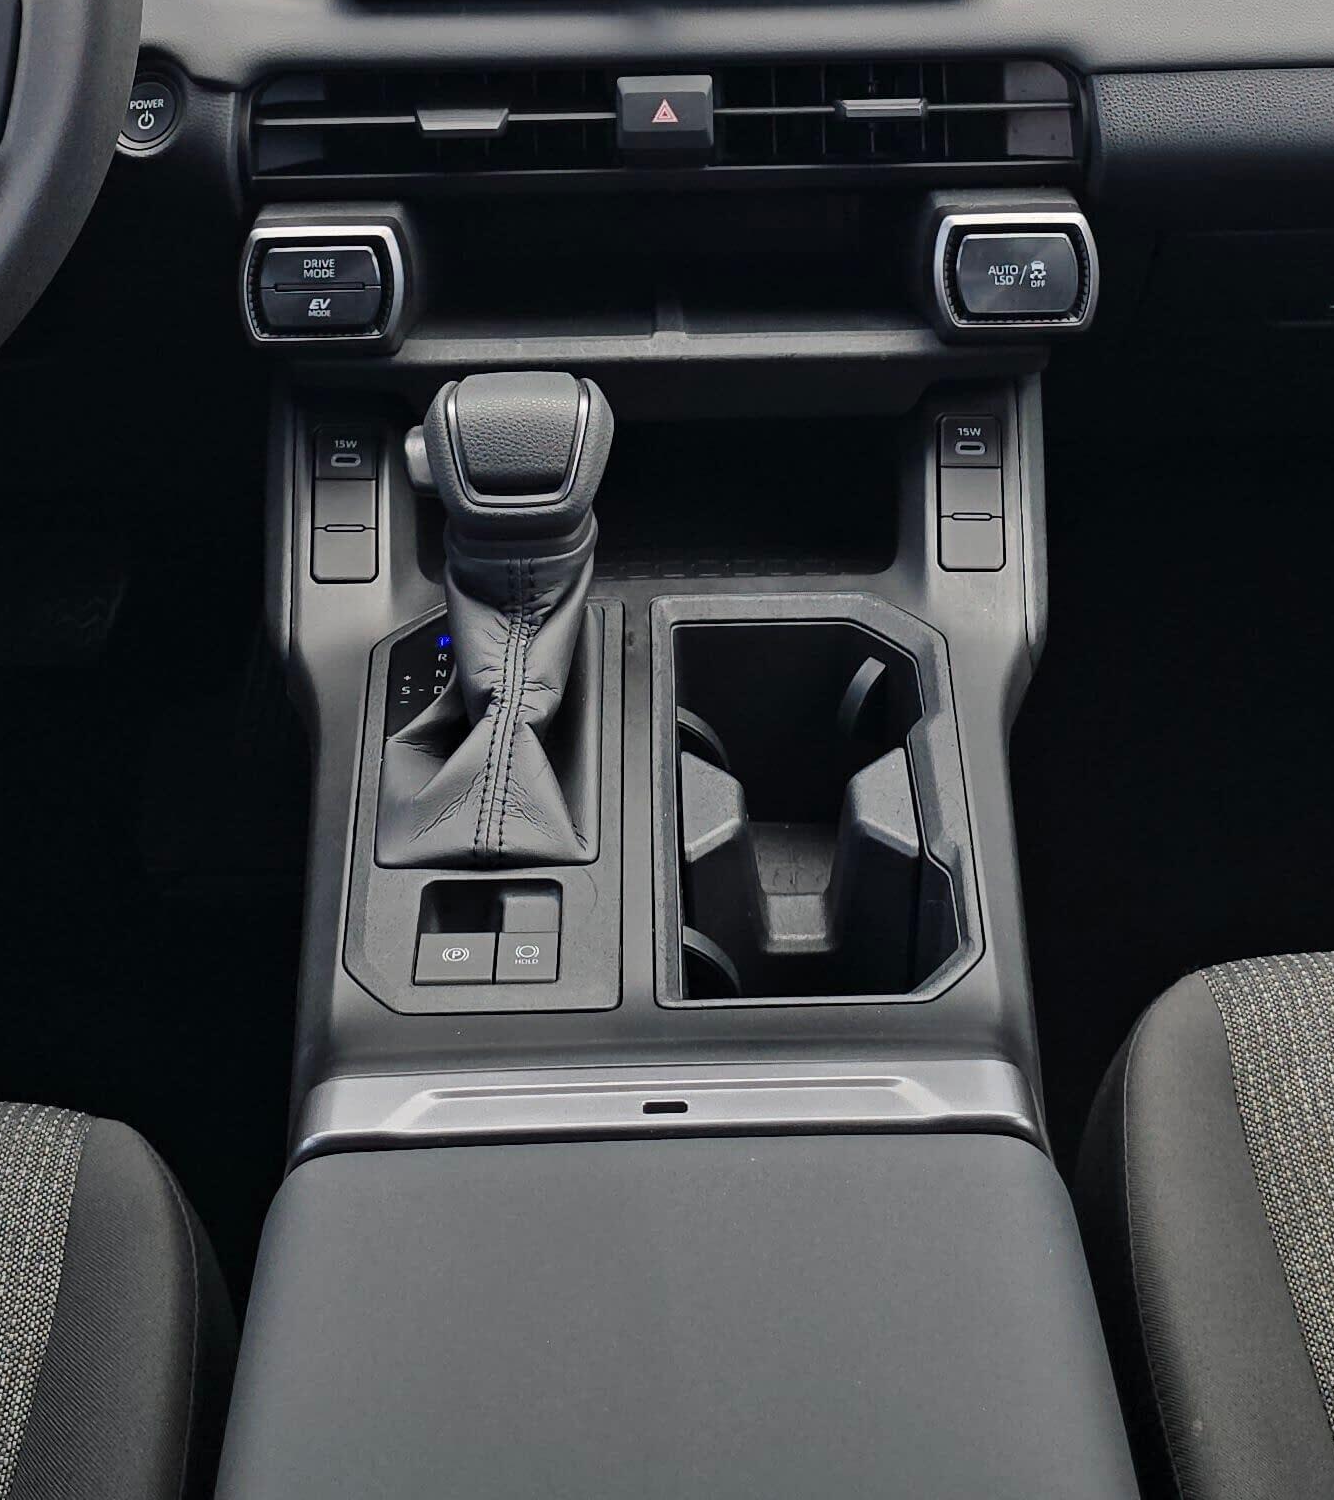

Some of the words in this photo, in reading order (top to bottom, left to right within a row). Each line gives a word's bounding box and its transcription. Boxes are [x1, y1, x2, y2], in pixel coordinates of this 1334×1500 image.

[129, 98, 165, 111] POWER
[303, 258, 336, 269] DRIVE
[303, 268, 336, 279] MODE
[988, 264, 1019, 276] AUTO
[994, 275, 1015, 286] LSD
[1030, 280, 1046, 288] OFF
[308, 298, 332, 310] EV
[307, 310, 332, 318] MODE
[957, 427, 982, 437] 15W
[334, 439, 358, 449] 15W
[437, 653, 448, 662] R
[435, 669, 447, 678] N
[400, 685, 411, 695] S
